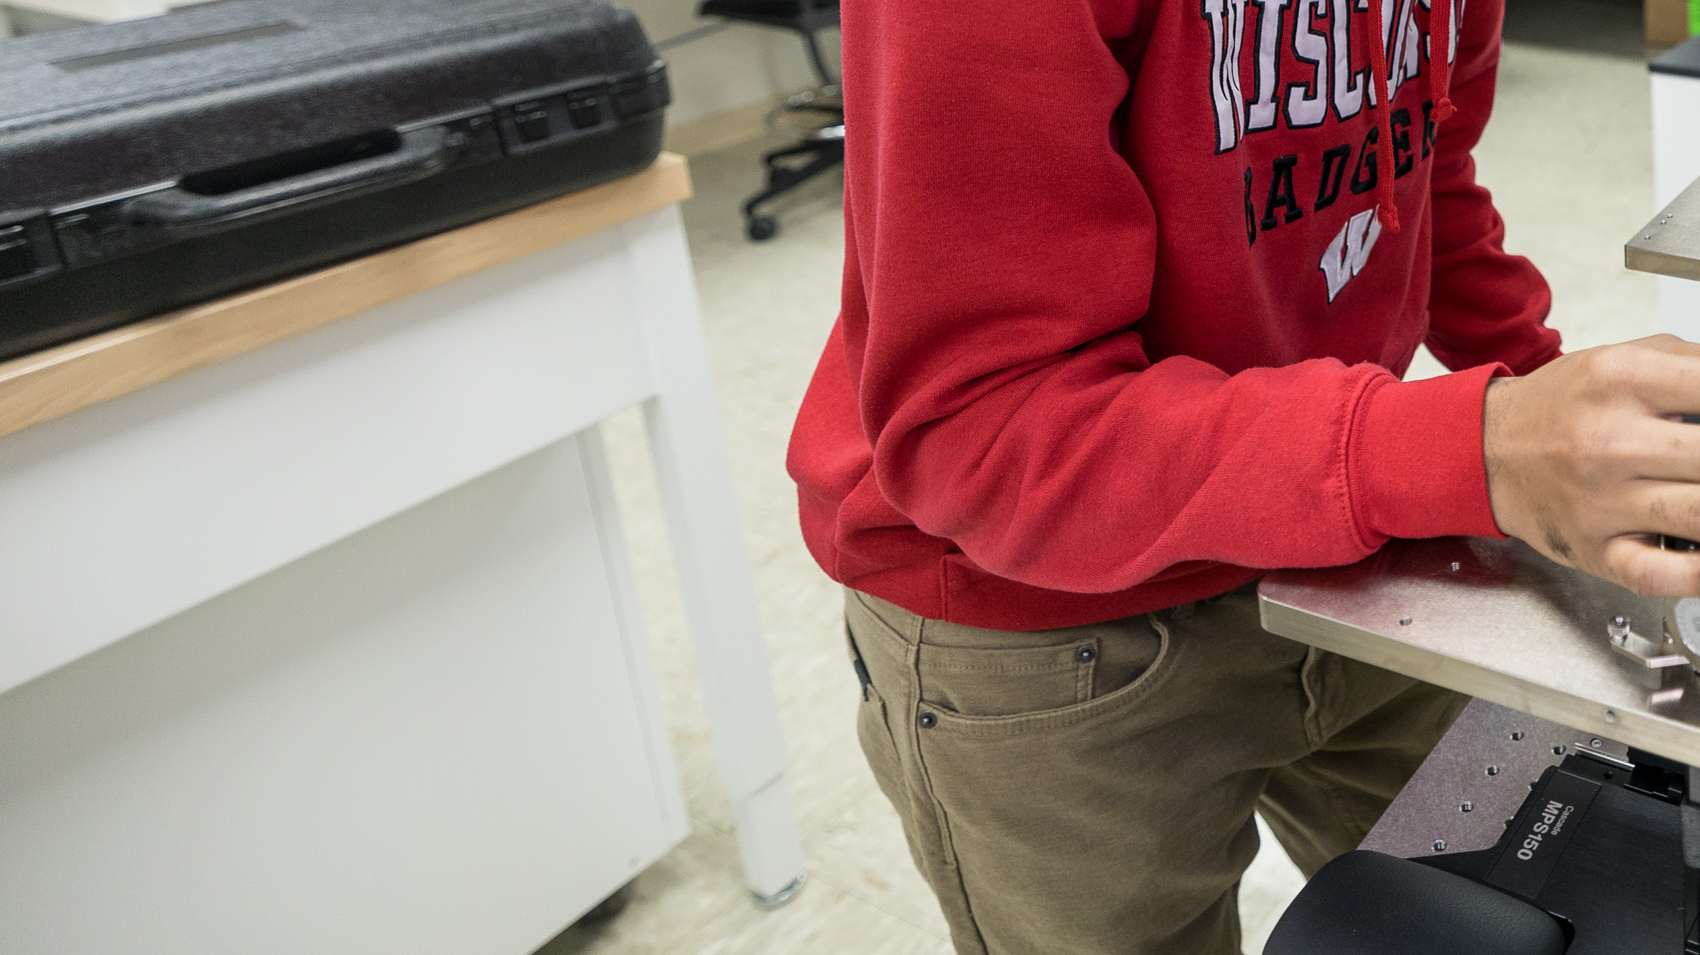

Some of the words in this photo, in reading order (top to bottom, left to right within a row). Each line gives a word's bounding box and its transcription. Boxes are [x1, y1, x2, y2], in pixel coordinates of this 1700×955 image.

[1318, 204, 1383, 306] W
[1516, 800, 1563, 861] MPS150
[1550, 805, 1574, 836] Cascade
